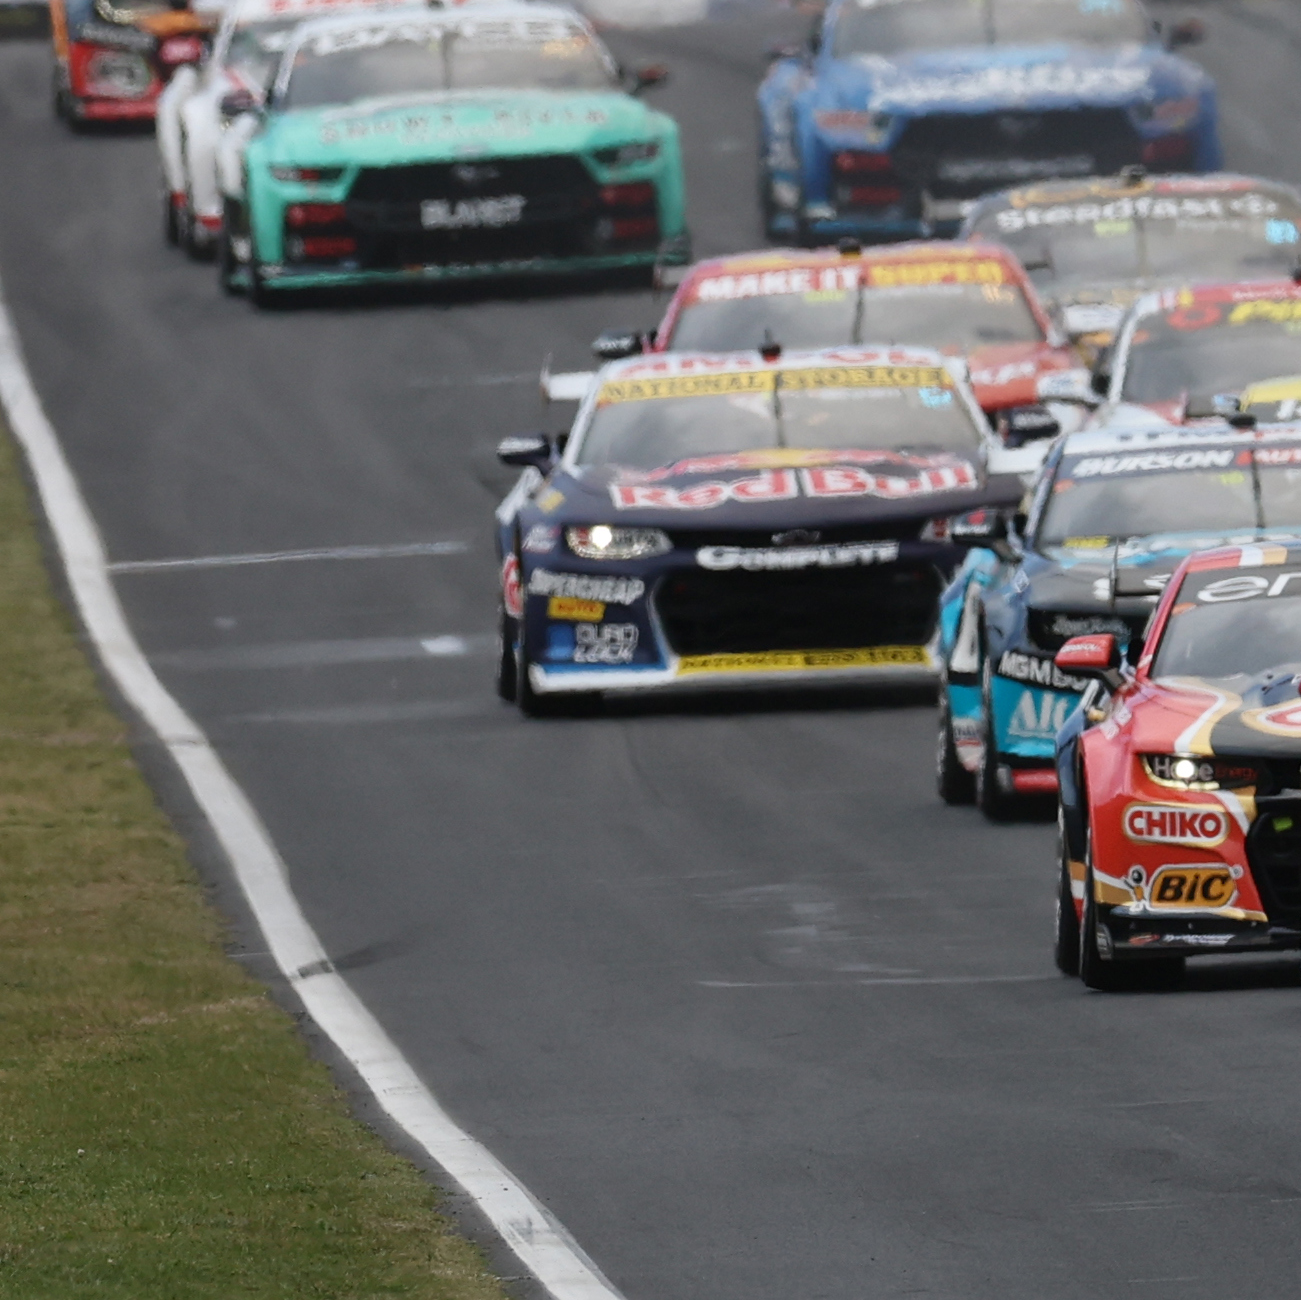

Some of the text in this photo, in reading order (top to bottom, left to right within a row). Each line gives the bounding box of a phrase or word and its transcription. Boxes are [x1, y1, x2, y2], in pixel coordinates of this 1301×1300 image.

[700, 270, 807, 301] MAKE
[818, 265, 862, 292] IT
[612, 460, 979, 511] Red Bull
[1128, 810, 1222, 838] CHIKO
